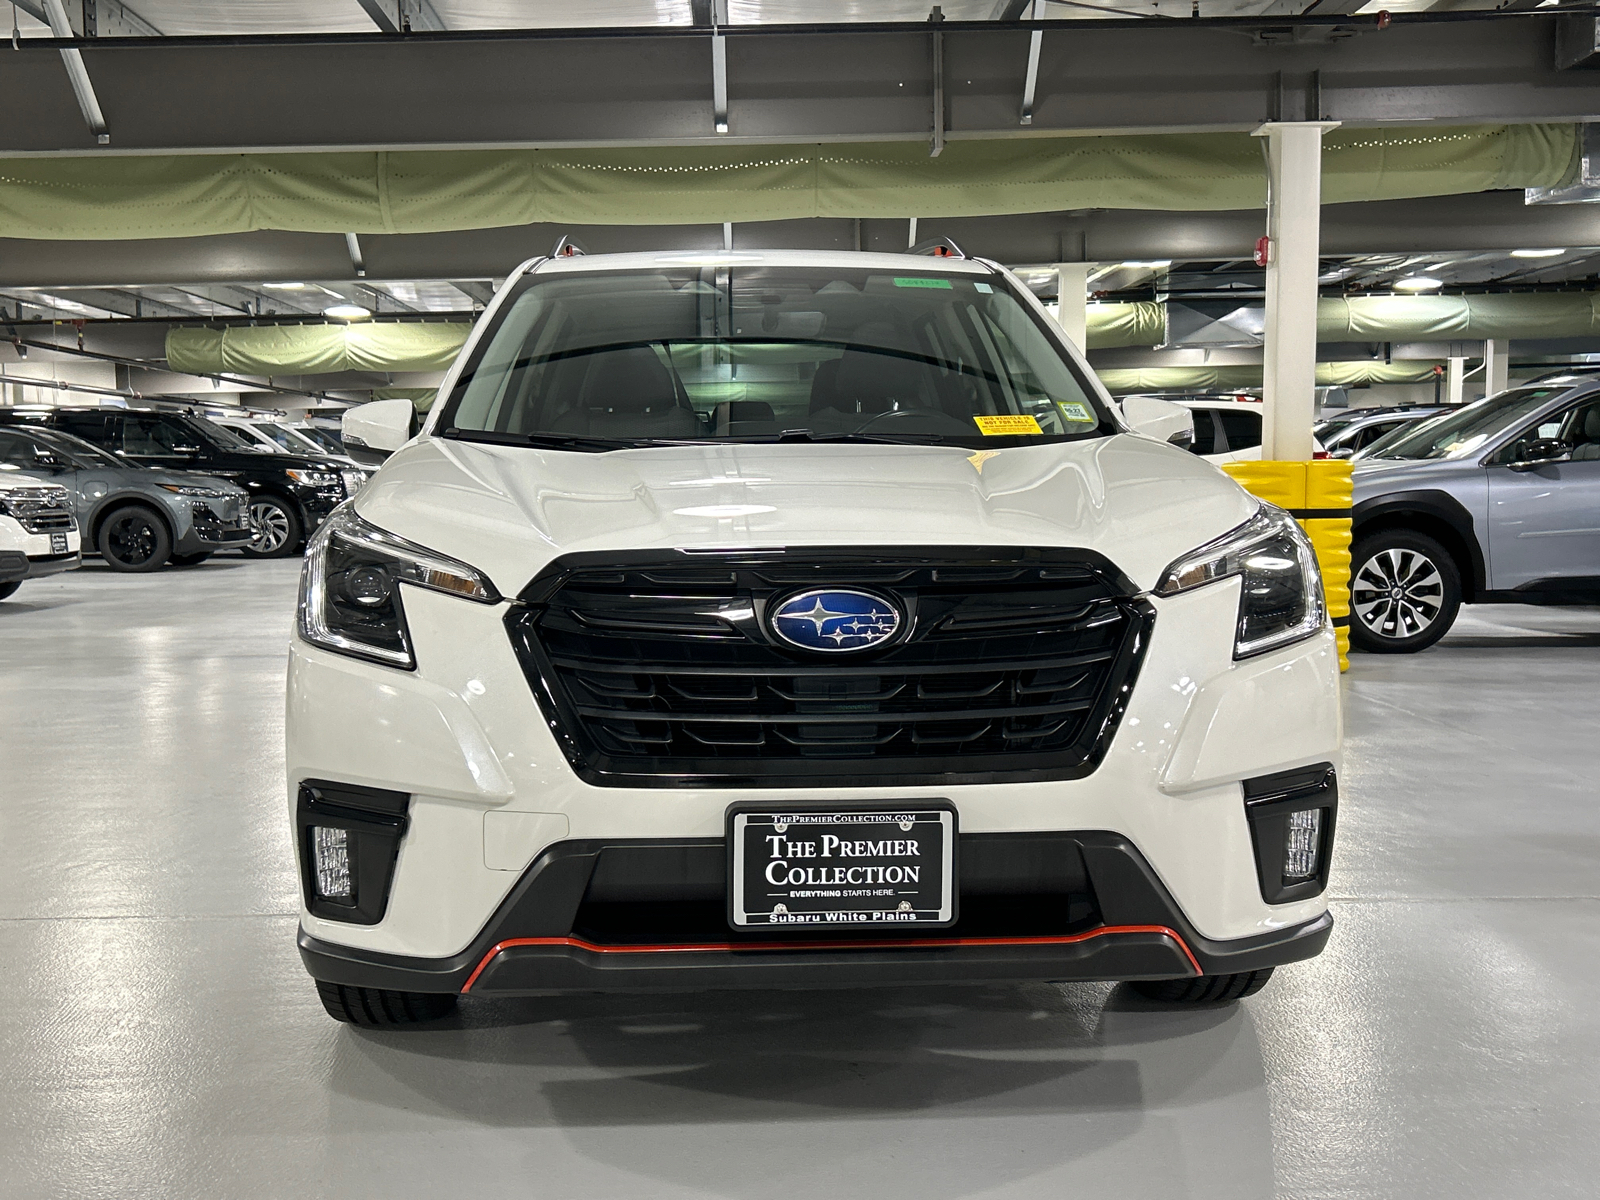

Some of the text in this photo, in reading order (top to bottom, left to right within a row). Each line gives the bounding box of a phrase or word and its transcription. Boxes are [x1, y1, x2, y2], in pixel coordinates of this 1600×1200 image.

[765, 834, 921, 859] THE PREMIER
[765, 860, 921, 885] COLLECTION
[789, 890, 841, 898] EVERYTHING
[842, 889, 872, 897] STARTS
[769, 910, 917, 923] Subaru White Plains
